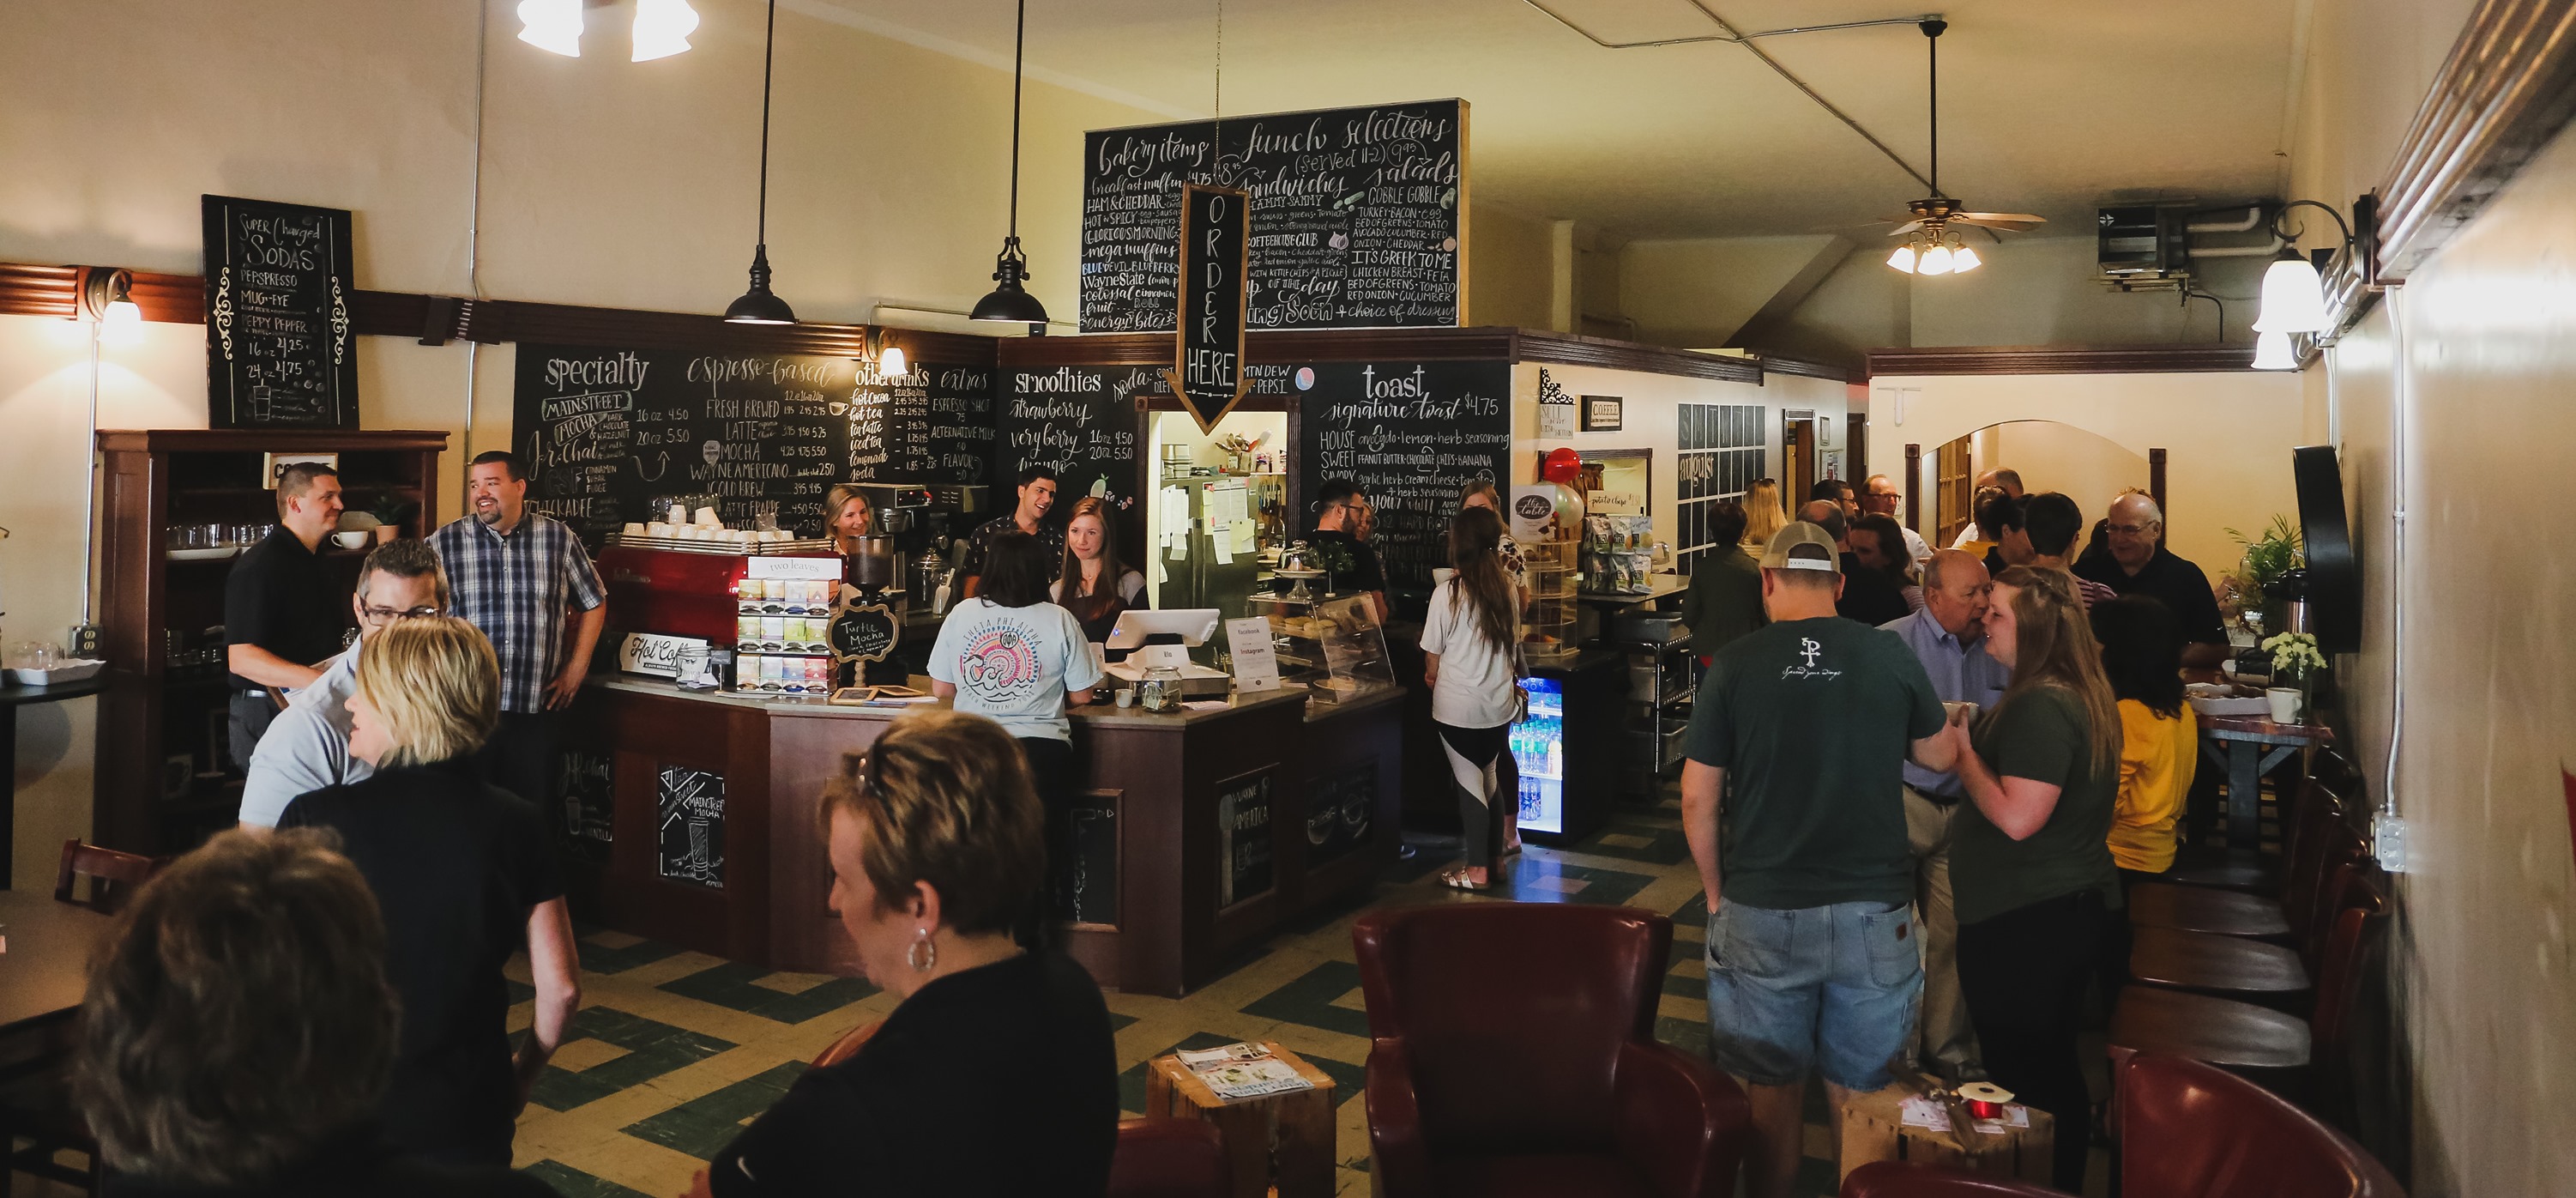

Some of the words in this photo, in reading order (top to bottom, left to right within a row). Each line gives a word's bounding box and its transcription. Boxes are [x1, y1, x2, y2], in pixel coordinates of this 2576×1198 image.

[1241, 118, 1327, 163] lunch
[1342, 110, 1452, 148] selections
[1100, 136, 1155, 178] bakery
[1160, 131, 1209, 167] items
[1363, 151, 1458, 186] salads
[1092, 174, 1142, 197] breakfast
[1408, 185, 1441, 203] GOBBLE
[1087, 197, 1108, 213] HAM
[1119, 194, 1165, 209] CHEDDAR
[1288, 194, 1324, 207] SAMMY
[1084, 214, 1101, 230] HOT
[1109, 211, 1137, 224] SPICY
[1358, 207, 1388, 217] TURKEY
[1391, 207, 1416, 218] BACON
[239, 214, 270, 241] SUPER
[273, 216, 320, 246] Charged
[1353, 228, 1386, 238] AVOCADO
[1431, 231, 1447, 239] RED
[1415, 220, 1448, 229] TOMATO
[1296, 233, 1318, 247] CLUB
[1386, 238, 1426, 251] CHEDDAR
[247, 234, 314, 271] SODAS
[1082, 244, 1122, 263] mega
[1125, 243, 1178, 263] muffins
[1380, 250, 1416, 267] GREEK
[1418, 253, 1433, 268] TO
[1434, 253, 1452, 270] ME
[1082, 263, 1103, 275] BLUE
[1104, 262, 1131, 272] DEVIL
[1203, 195, 1225, 344] ORDER
[1353, 267, 1390, 277] CHICKEN
[1391, 267, 1424, 278] BREAST
[1427, 269, 1450, 281] FETA
[240, 269, 297, 287] PEPSPRESSO
[1348, 279, 1364, 289] BED
[1378, 279, 1415, 290] GREENS
[1420, 281, 1456, 293] TOMATO
[1300, 275, 1341, 310] day
[1348, 291, 1364, 300] RED
[1365, 290, 1395, 300] ONION
[1399, 290, 1451, 302] CUCUMBER
[1087, 302, 1116, 316] fruit
[242, 314, 270, 329] PEPPY
[274, 317, 307, 333] PEPPER
[1087, 316, 1131, 331] energy
[1135, 312, 1169, 330] bites
[249, 342, 261, 356] 16
[277, 337, 303, 358] 4.25
[246, 364, 261, 378] 24
[275, 360, 302, 382] 4.75
[545, 351, 649, 391] specialty
[1187, 348, 1235, 386] HERE
[1264, 366, 1291, 377] DEW
[941, 368, 986, 390] extras
[1015, 366, 1101, 393] smoothies
[1258, 378, 1288, 394] PEPSI
[1362, 365, 1425, 399] toast
[850, 388, 866, 405] hot
[932, 398, 968, 412] ESPRESSO
[636, 409, 648, 421] 16
[651, 412, 662, 421] oz
[668, 408, 689, 421] 4.50
[706, 399, 739, 418] FRESH
[745, 400, 780, 418] BREWED
[848, 407, 866, 421] hot
[867, 407, 883, 419] tea
[1009, 397, 1093, 428] strawberry
[1320, 398, 1411, 429] signature
[1411, 392, 1463, 420] toast
[1465, 391, 1499, 416] $4.75
[559, 413, 597, 442] MOCHA
[637, 432, 649, 445] 20
[651, 434, 661, 445] oz
[667, 428, 690, 443] 5.50
[727, 421, 758, 441] LATTE
[932, 426, 978, 439] ALTERNATIVE
[979, 427, 996, 440] MILK
[870, 437, 882, 447] tea
[1115, 431, 1133, 445] 4.50
[1320, 430, 1355, 451] HOUSE
[1402, 430, 1433, 445] lemon
[1438, 428, 1462, 445] herb
[1464, 433, 1510, 451] seasoning
[721, 443, 760, 461] MOCHA
[848, 448, 889, 468] lemonade
[943, 453, 974, 469] FLAVOR
[1114, 447, 1133, 460] 5.50
[1321, 451, 1356, 469] SWEET
[1358, 454, 1381, 465] PEANUT
[1383, 453, 1404, 465] BUTTER
[1406, 453, 1435, 465] CHOCOLATE
[1437, 454, 1455, 465] CHIPS
[1458, 454, 1492, 467] BANANA
[849, 467, 875, 482] soda
[1358, 473, 1382, 486] garlic
[1383, 472, 1403, 485] herb
[1405, 474, 1429, 485] cream
[1430, 472, 1456, 484] cheese
[1680, 453, 1714, 487] august
[739, 481, 764, 497] BREW
[1397, 487, 1418, 498] herb
[1420, 487, 1459, 499] seasoning
[1370, 494, 1402, 512] your
[769, 562, 789, 572] two
[791, 560, 819, 573] leaves
[841, 621, 878, 634] Turtle
[963, 620, 991, 640] THETA
[1018, 621, 1042, 645] ALPHA
[850, 632, 884, 645] Mocha
[630, 637, 658, 663] Hot
[695, 808, 721, 818] MOCHA
